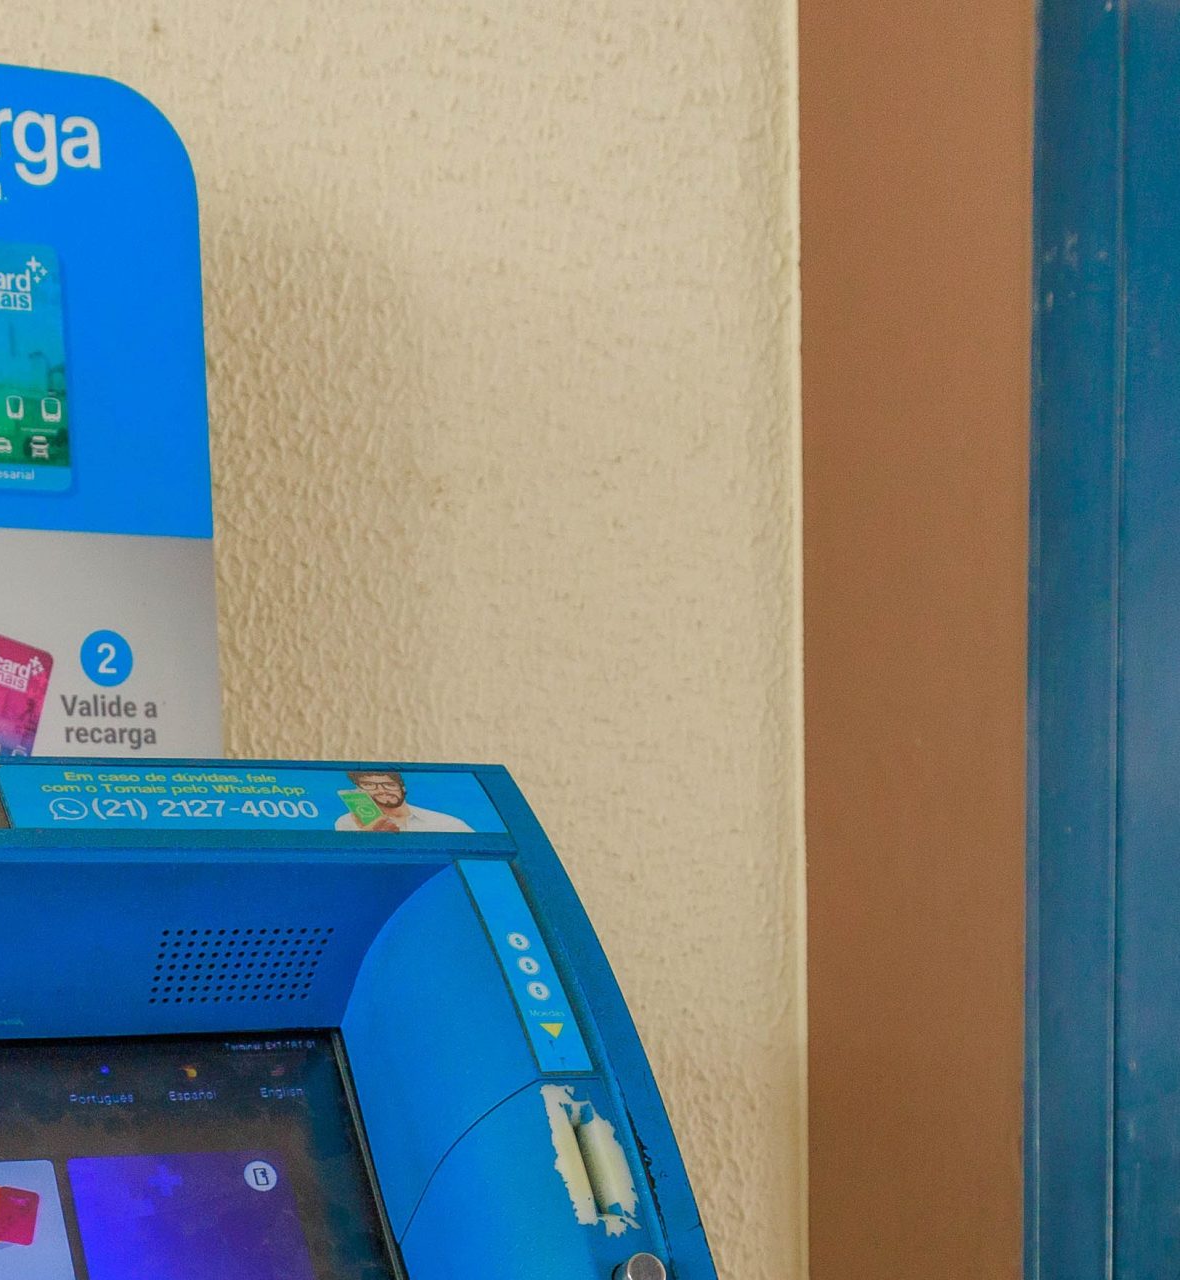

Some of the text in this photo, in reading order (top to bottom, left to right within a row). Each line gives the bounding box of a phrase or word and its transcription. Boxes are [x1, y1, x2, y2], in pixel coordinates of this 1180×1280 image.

[96, 643, 117, 674] 2
[61, 694, 158, 719] Valide a
[64, 723, 157, 750] recarga
[63, 771, 277, 784] Em caso de dúvidas, fale
[41, 783, 84, 794] com
[85, 784, 98, 794] o
[104, 783, 168, 795] Tomais
[171, 784, 209, 797] pelo
[91, 798, 319, 821] (21) 2127-4000
